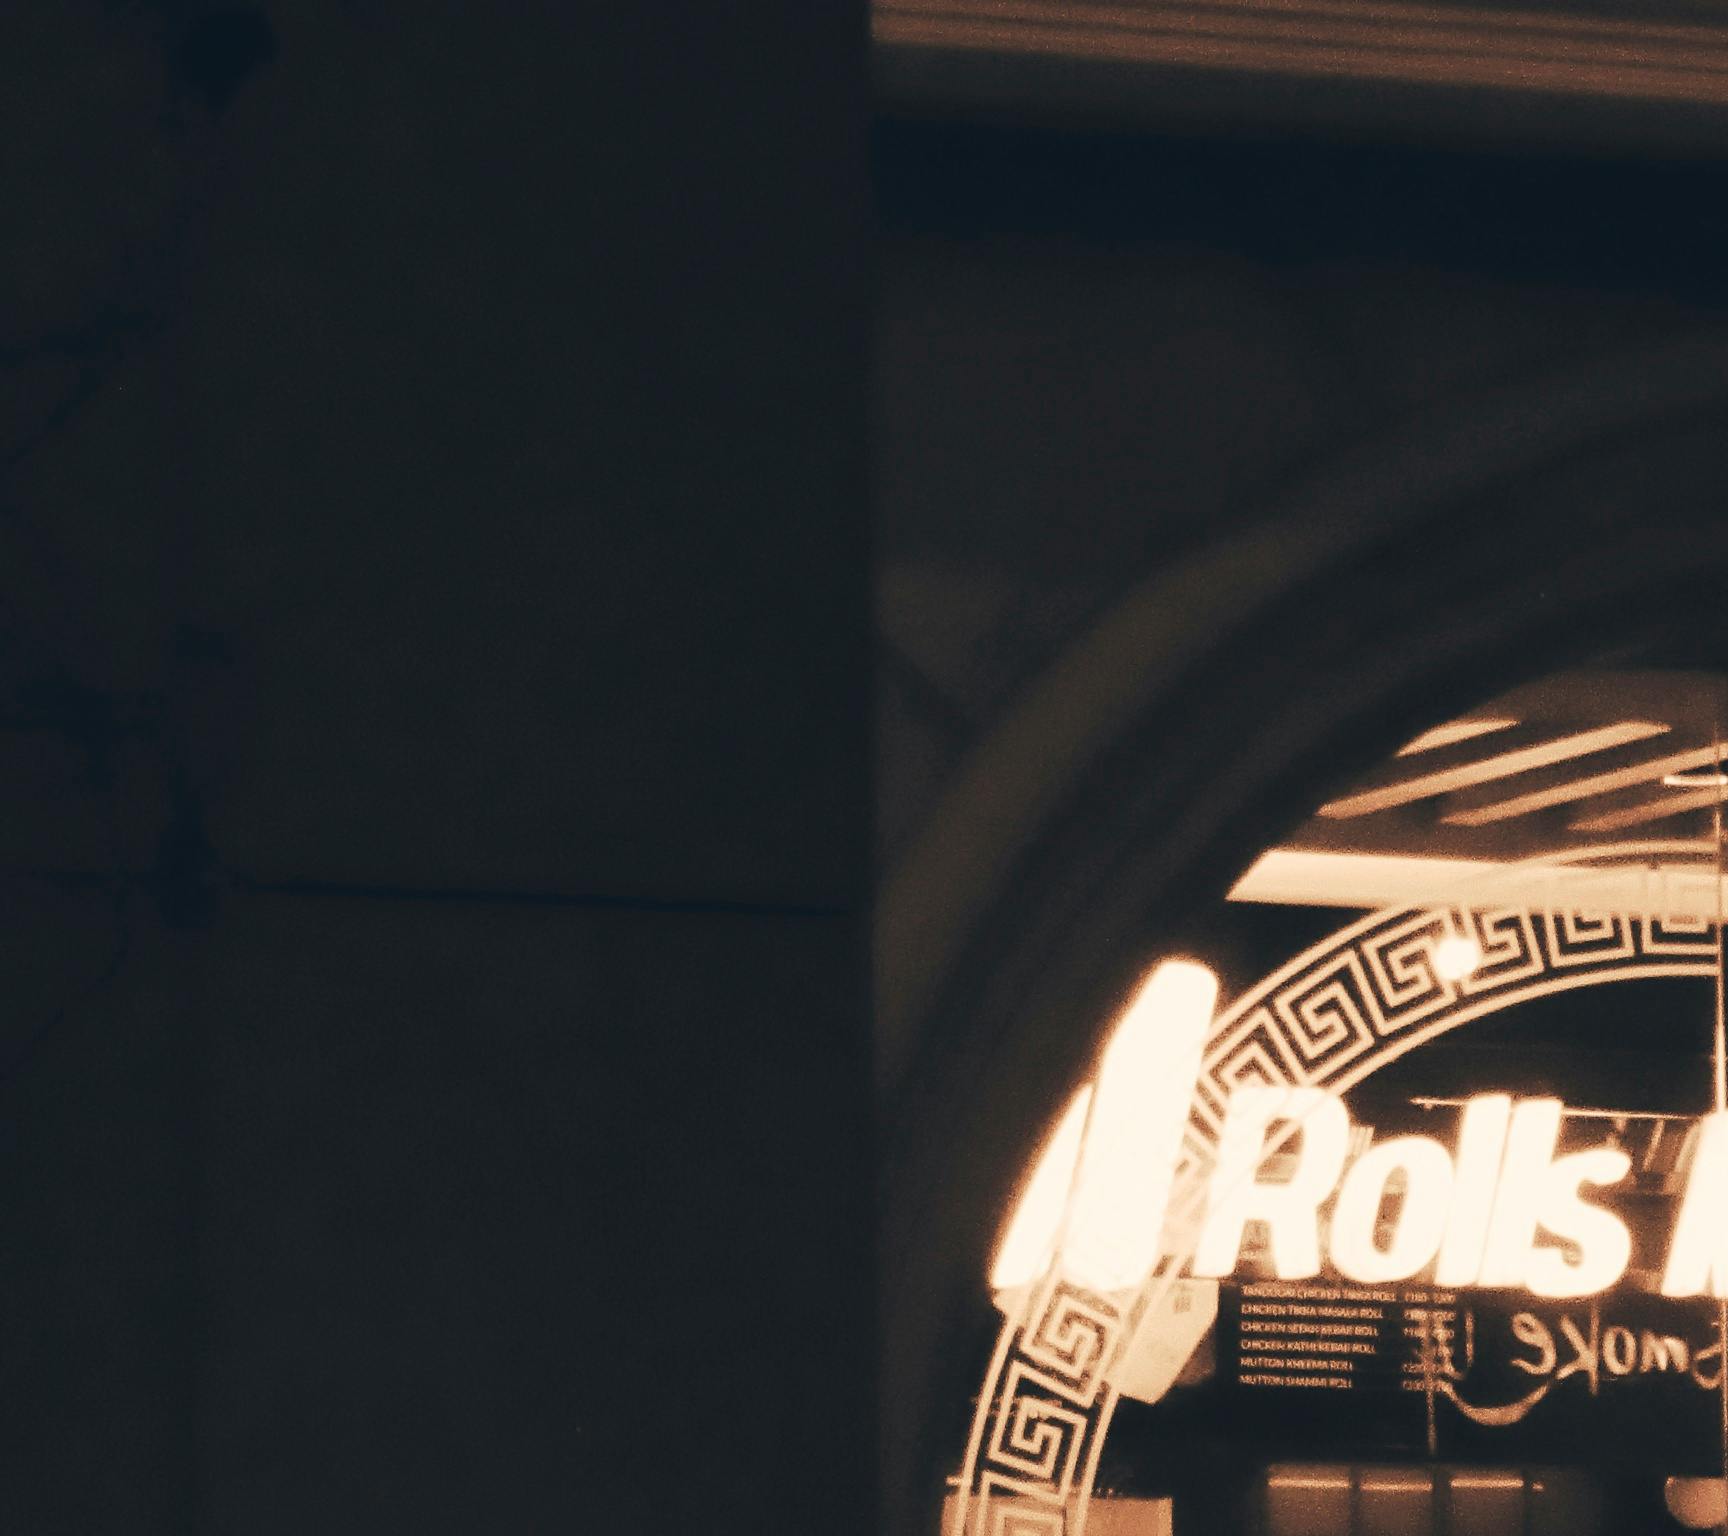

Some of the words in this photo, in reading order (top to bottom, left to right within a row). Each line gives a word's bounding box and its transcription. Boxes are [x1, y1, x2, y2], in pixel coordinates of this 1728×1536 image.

[1192, 1085, 1632, 1298] Rolls
[1360, 1307, 1383, 1319] ROLL
[1354, 1325, 1379, 1337] ROLL
[1352, 1342, 1377, 1354] ROLL
